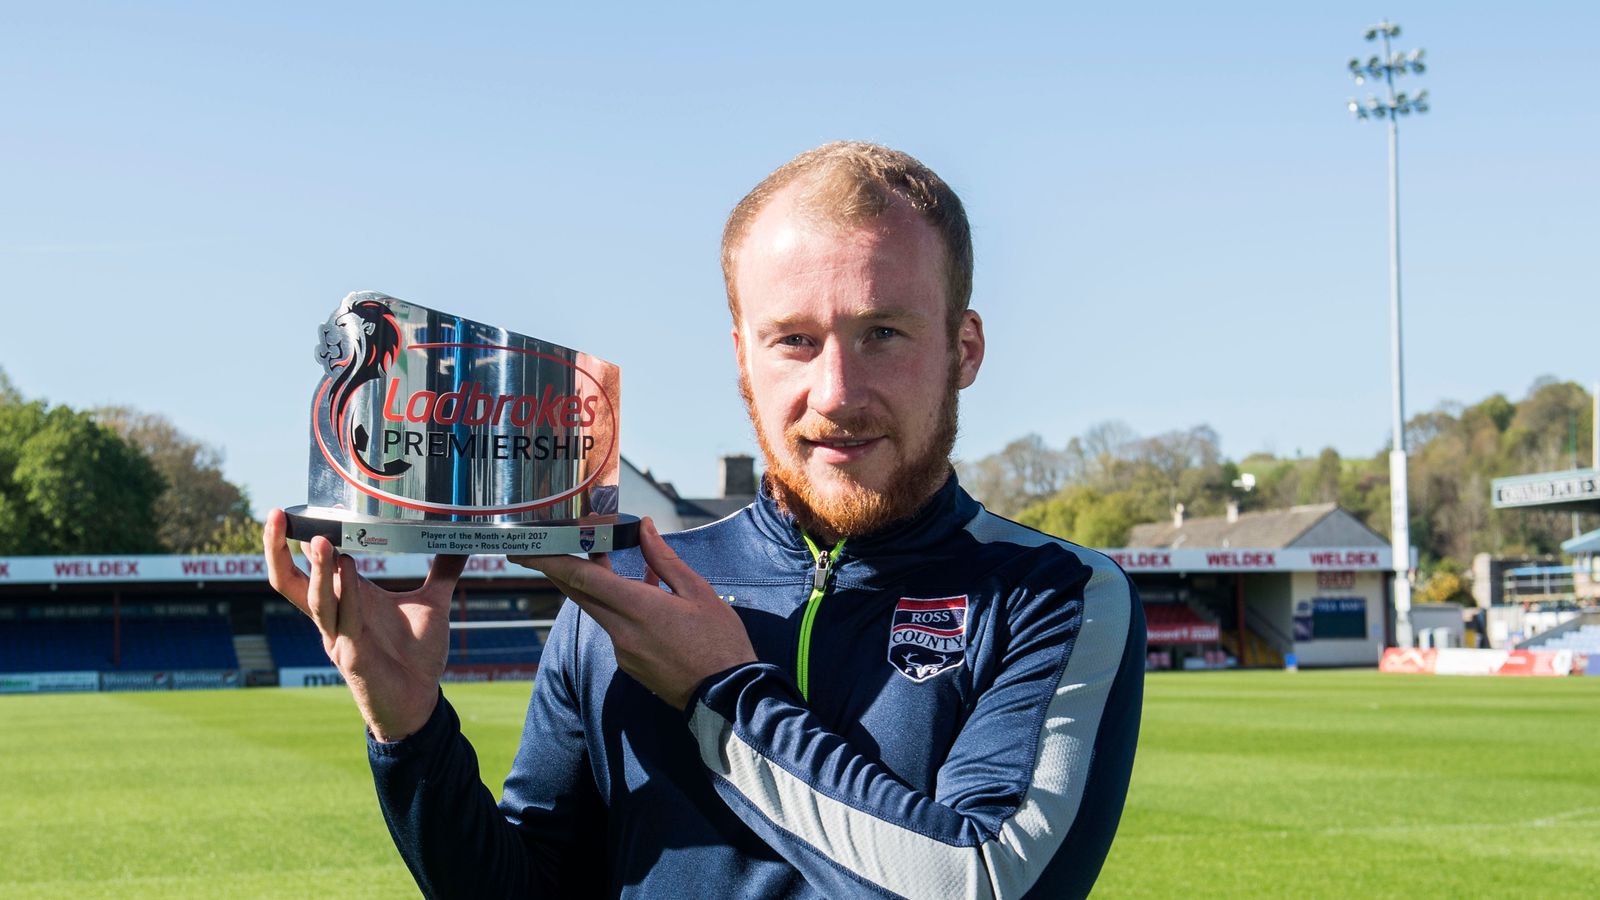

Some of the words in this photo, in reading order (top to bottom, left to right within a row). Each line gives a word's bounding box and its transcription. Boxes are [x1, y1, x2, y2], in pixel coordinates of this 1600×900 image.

[383, 377, 598, 427] Ladbrokes
[383, 429, 595, 460] PREMIERSHIP
[421, 531, 446, 541] Player
[448, 531, 458, 540] of
[459, 531, 472, 540] the
[474, 532, 499, 540] Month
[507, 532, 526, 541] April
[528, 532, 548, 540] 2017
[427, 541, 447, 549] Liam
[449, 541, 473, 551] Boyce
[481, 542, 500, 550] Ross
[502, 542, 529, 551] County
[531, 542, 542, 550] FC
[181, 559, 264, 575] WELDEX
[1206, 552, 1276, 567] WELDEX
[1310, 551, 1379, 567] WELDEX
[53, 560, 140, 577] WELDEX
[911, 611, 950, 623] ROSS
[892, 630, 963, 650] COUNTY
